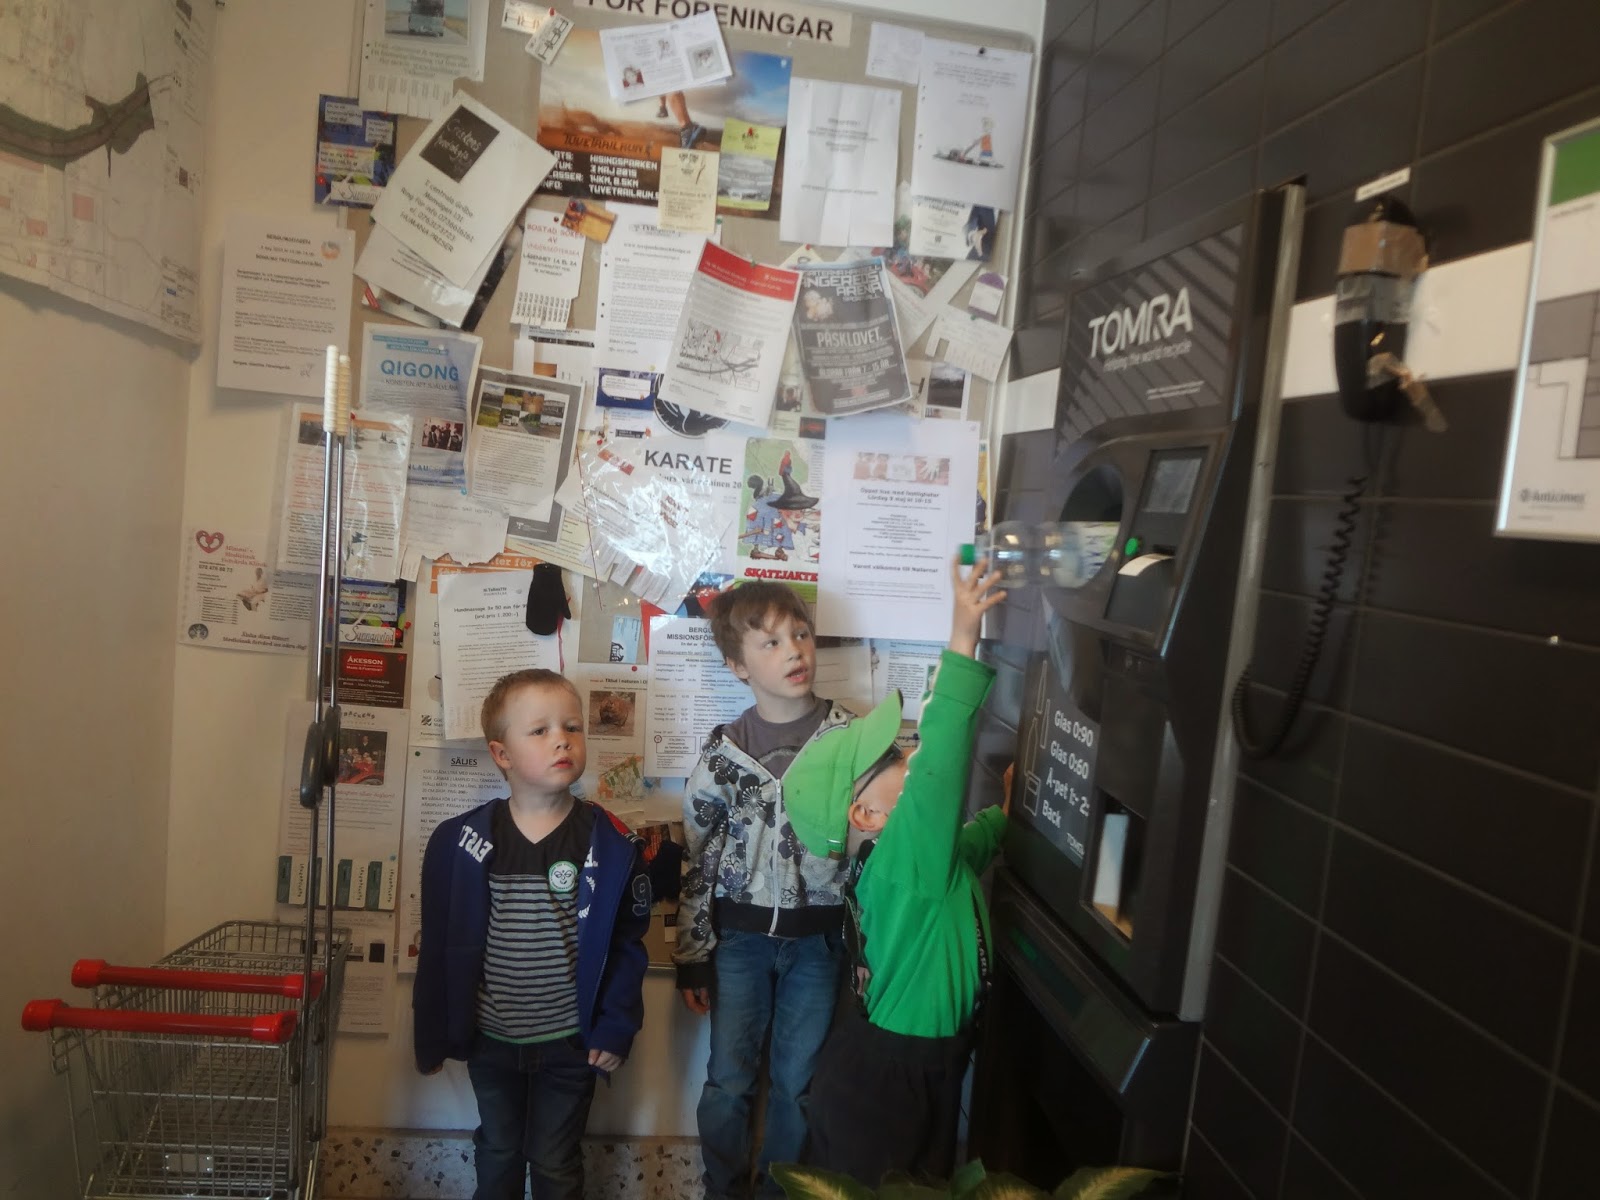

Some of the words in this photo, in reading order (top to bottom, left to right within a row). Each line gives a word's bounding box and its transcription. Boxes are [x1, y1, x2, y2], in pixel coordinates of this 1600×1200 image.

[590, 154, 658, 170] HISINGSPARKEN
[597, 166, 615, 176] MAJ
[616, 168, 637, 177] 2015
[1088, 287, 1193, 358] TOMRA
[381, 359, 459, 381] QIGONG
[644, 450, 732, 475] KARATE
[1054, 709, 1072, 735] Glas
[1073, 722, 1094, 748] 0:90
[450, 756, 478, 766] SÄLJES
[1050, 740, 1067, 765] Glas
[1068, 752, 1090, 780] 0:60
[1042, 799, 1062, 829] Back
[631, 873, 652, 917] 9
